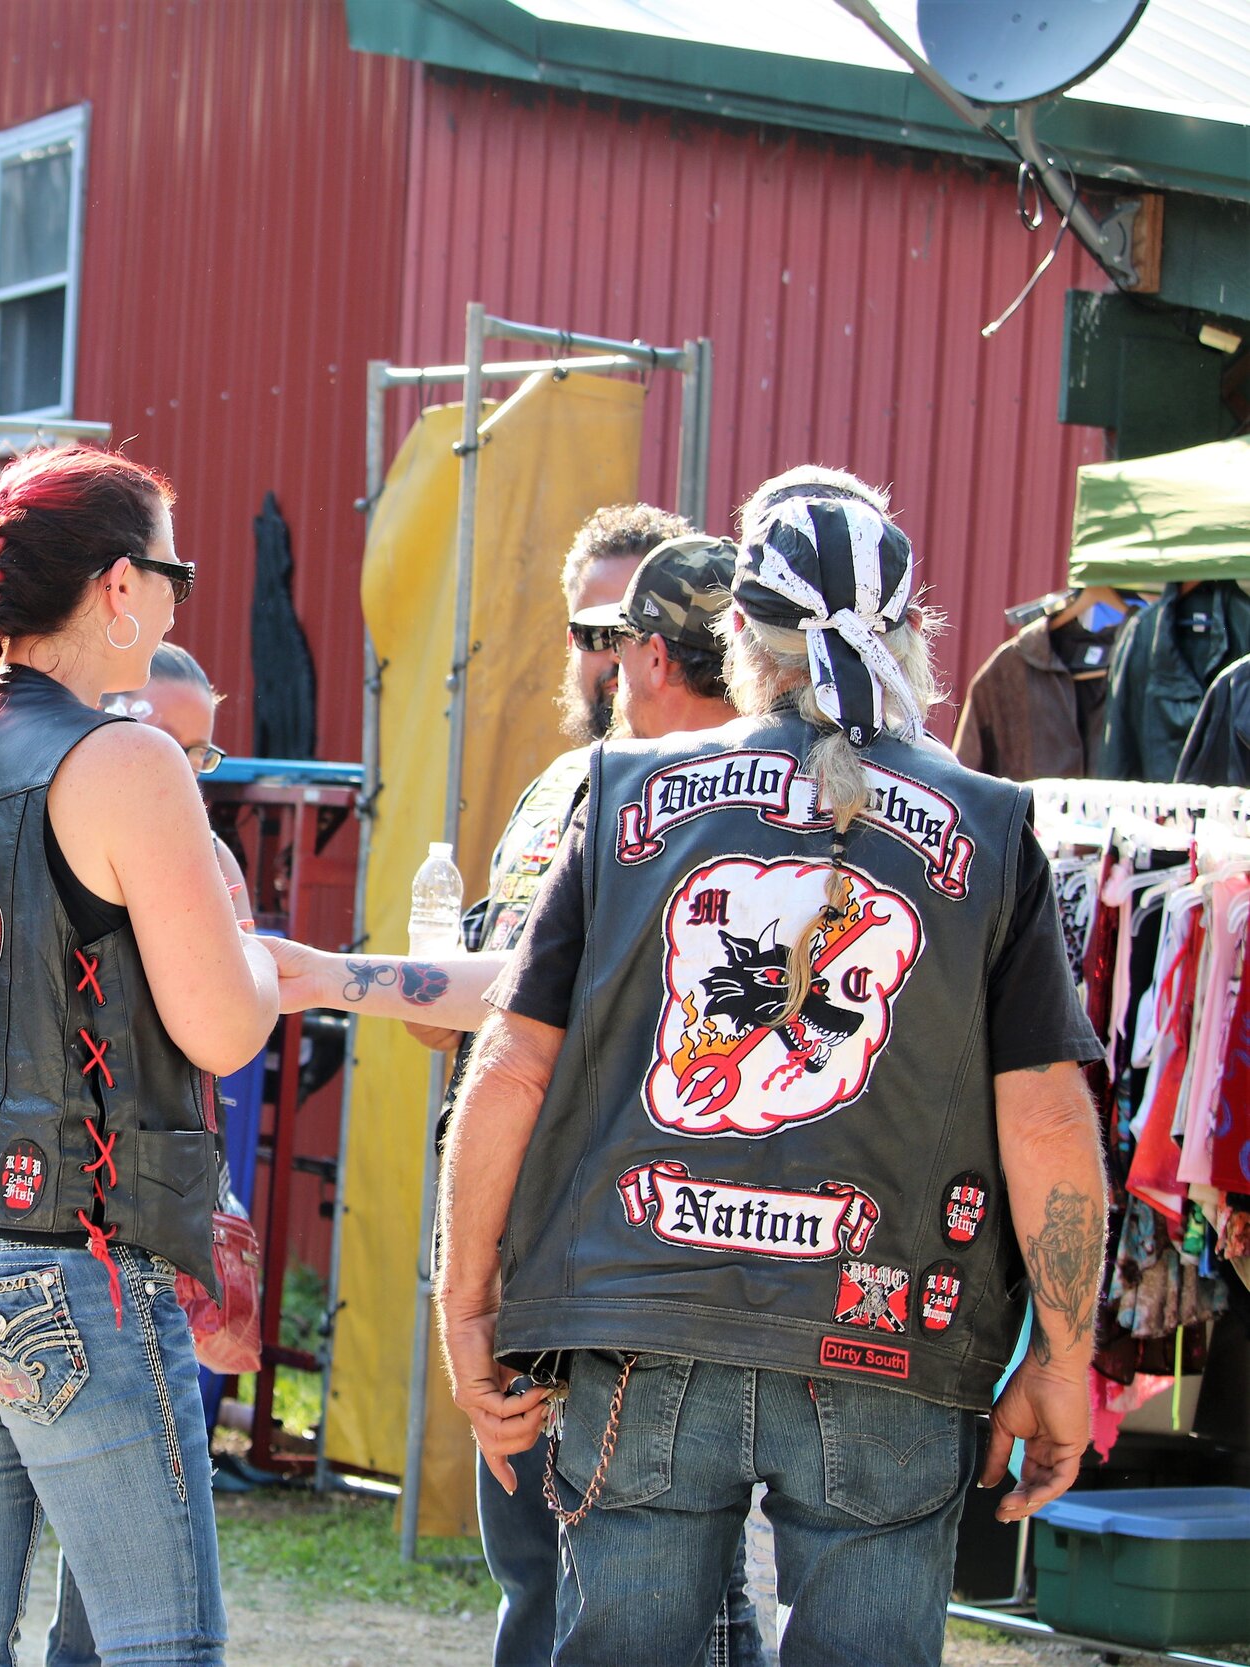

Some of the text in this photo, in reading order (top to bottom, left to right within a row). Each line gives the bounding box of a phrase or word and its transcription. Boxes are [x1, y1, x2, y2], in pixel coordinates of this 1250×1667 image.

[656, 759, 946, 848] Diablo bos
[685, 888, 731, 927] M
[841, 966, 874, 1004] C
[670, 1186, 824, 1248] Nation
[947, 1213, 977, 1236] Tiny
[826, 1344, 904, 1370] Dirty South
